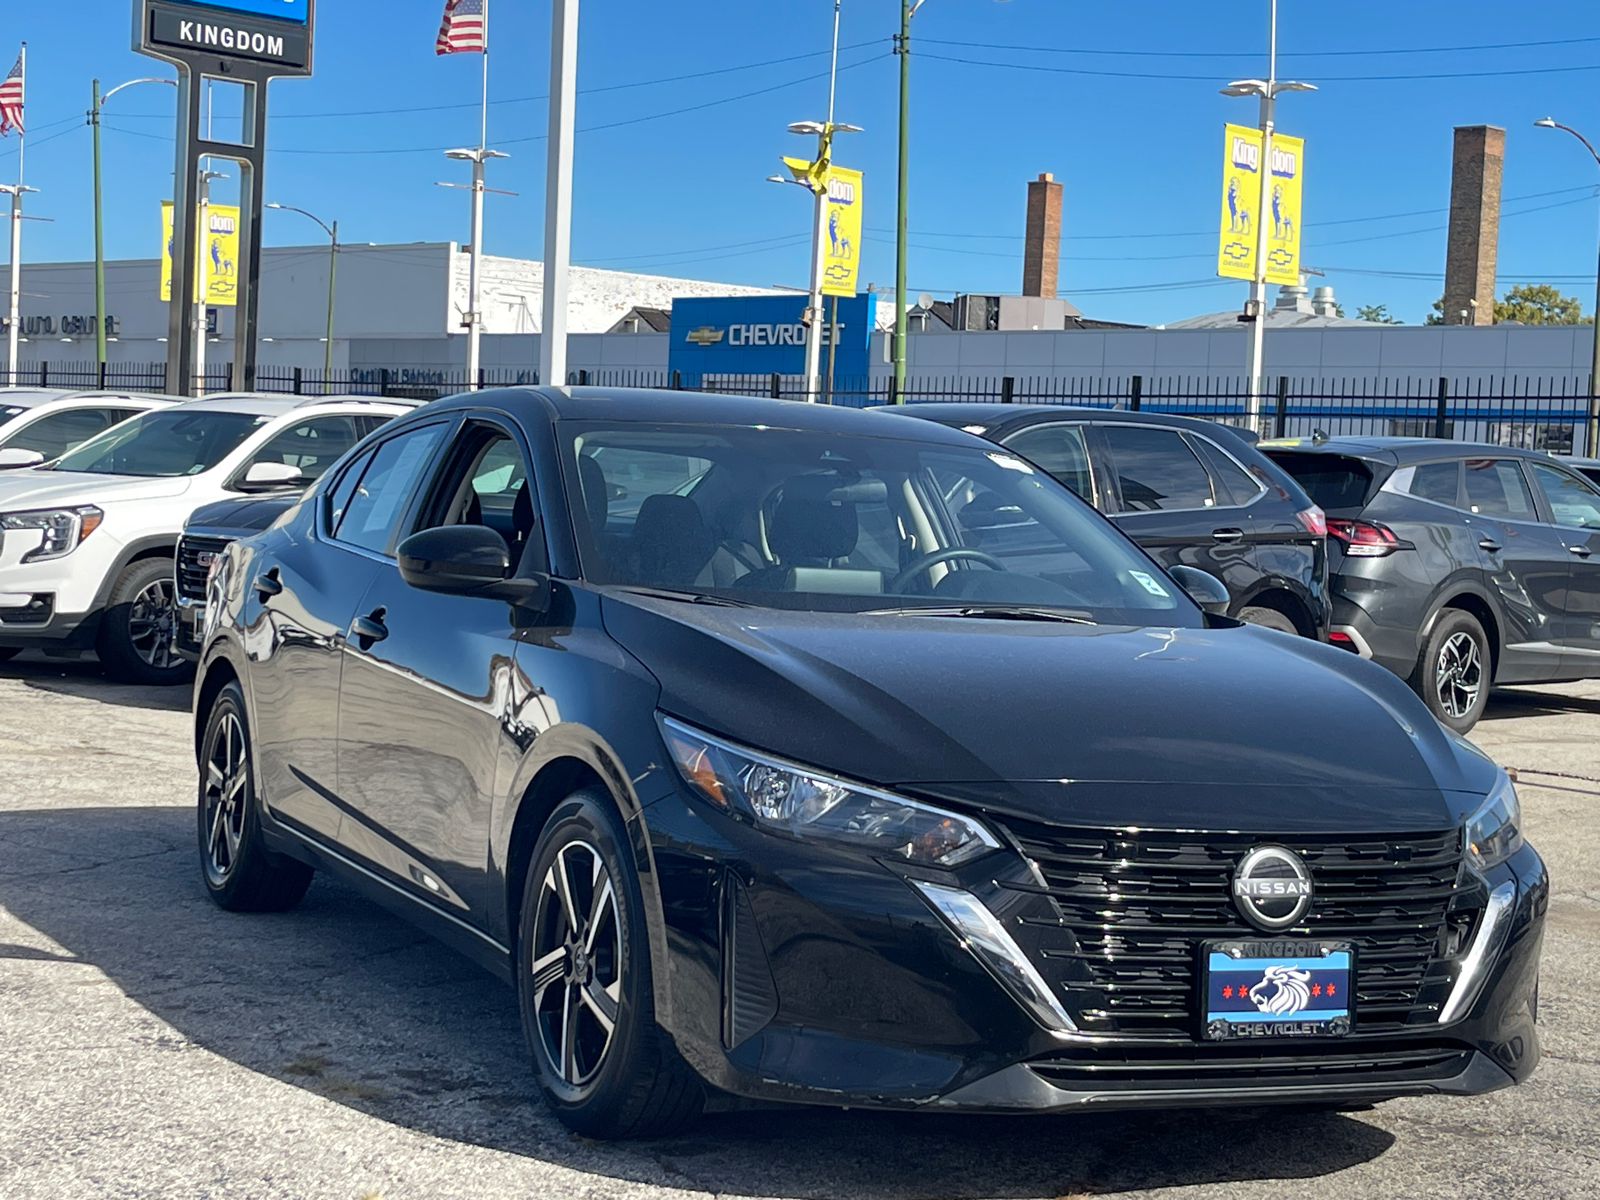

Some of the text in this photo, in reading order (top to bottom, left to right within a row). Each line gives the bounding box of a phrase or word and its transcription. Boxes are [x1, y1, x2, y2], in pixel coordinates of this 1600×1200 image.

[180, 21, 283, 56] KINGDOM
[1232, 137, 1258, 171] King
[1271, 147, 1296, 177] dom
[828, 177, 854, 204] dom
[210, 213, 235, 232] dom
[61, 316, 117, 334] CENTR
[729, 323, 845, 346] CHEVROET
[1237, 881, 1310, 895] NISSAN
[1241, 941, 1321, 957] KINGDOM
[1237, 1022, 1321, 1036] CHEVROLET
